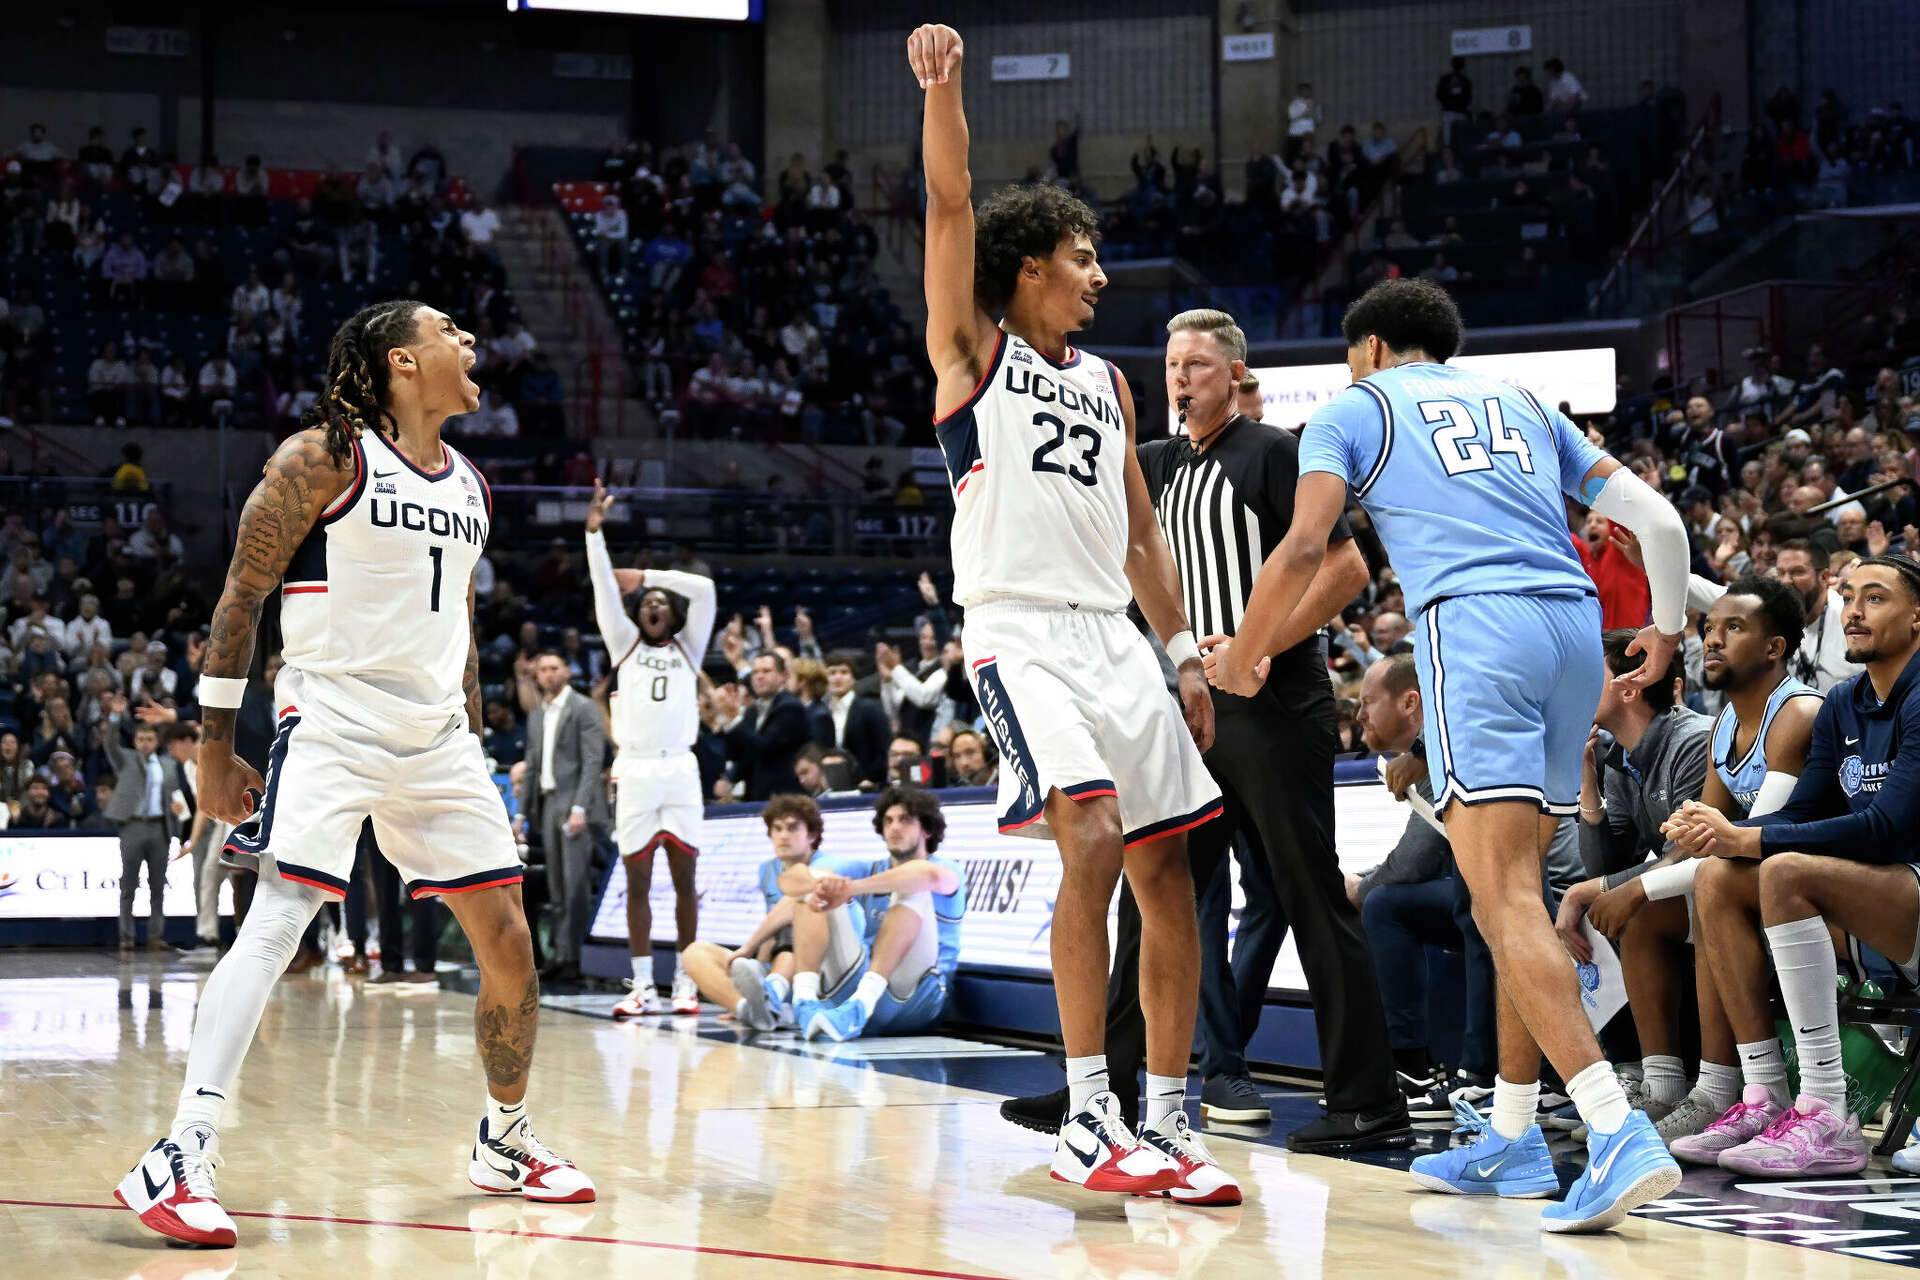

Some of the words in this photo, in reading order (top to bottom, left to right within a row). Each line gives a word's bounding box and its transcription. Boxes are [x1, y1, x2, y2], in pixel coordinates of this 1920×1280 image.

[1046, 57, 1059, 74] 7
[1230, 40, 1267, 53] WEST
[1005, 365, 1120, 431] UCONN
[1031, 411, 1102, 487] 23
[1416, 396, 1535, 477] 24
[374, 486, 397, 495] CHANGE
[370, 498, 487, 549] UCONN
[897, 514, 937, 537] 117
[428, 545, 443, 613] 1
[636, 653, 682, 671] UCON
[651, 675, 668, 702] 0
[982, 678, 1035, 811] HUSKIES
[1625, 1197, 1920, 1260] HEAL
